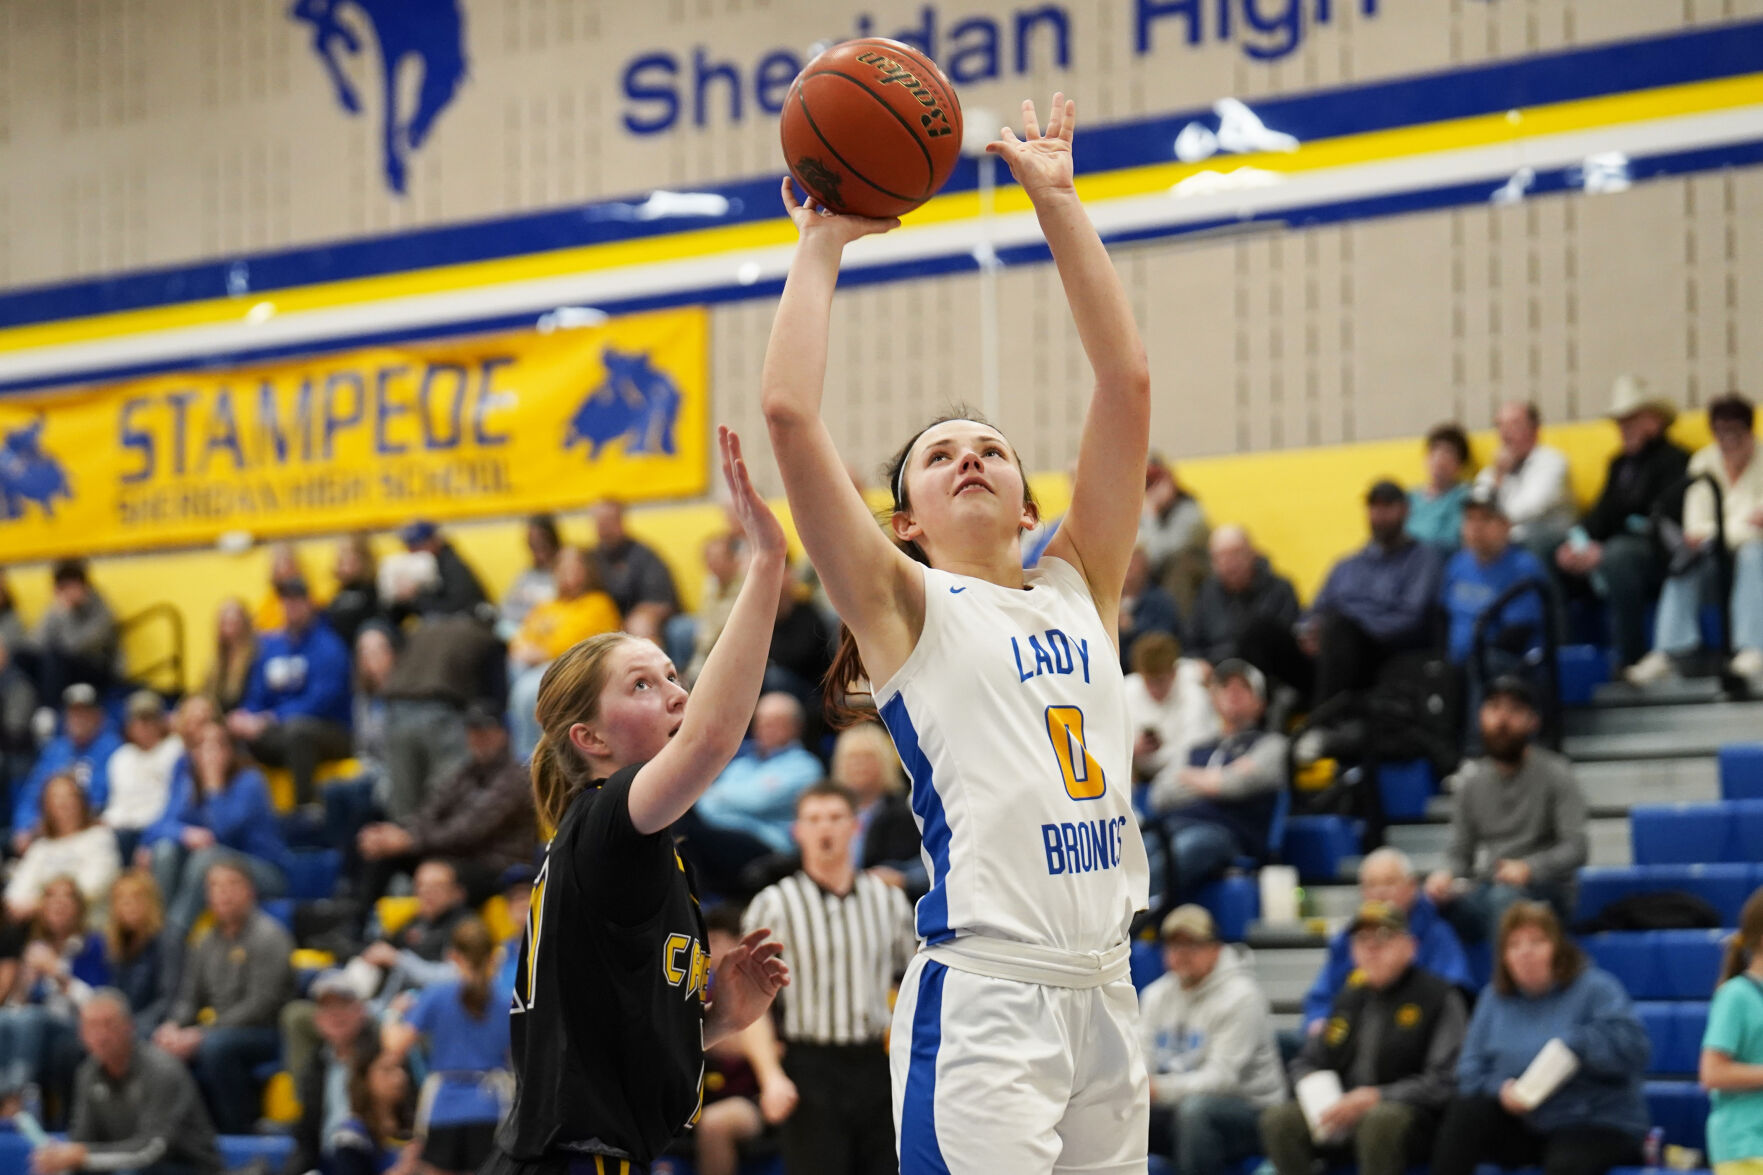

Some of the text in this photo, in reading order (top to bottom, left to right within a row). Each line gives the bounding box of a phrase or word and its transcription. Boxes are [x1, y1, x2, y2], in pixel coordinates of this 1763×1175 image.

[619, 2, 1071, 137] Shedan
[856, 51, 952, 138] Baden
[118, 355, 517, 484] STAMPEDE
[1011, 628, 1091, 684] LADY
[1044, 704, 1106, 801] 0
